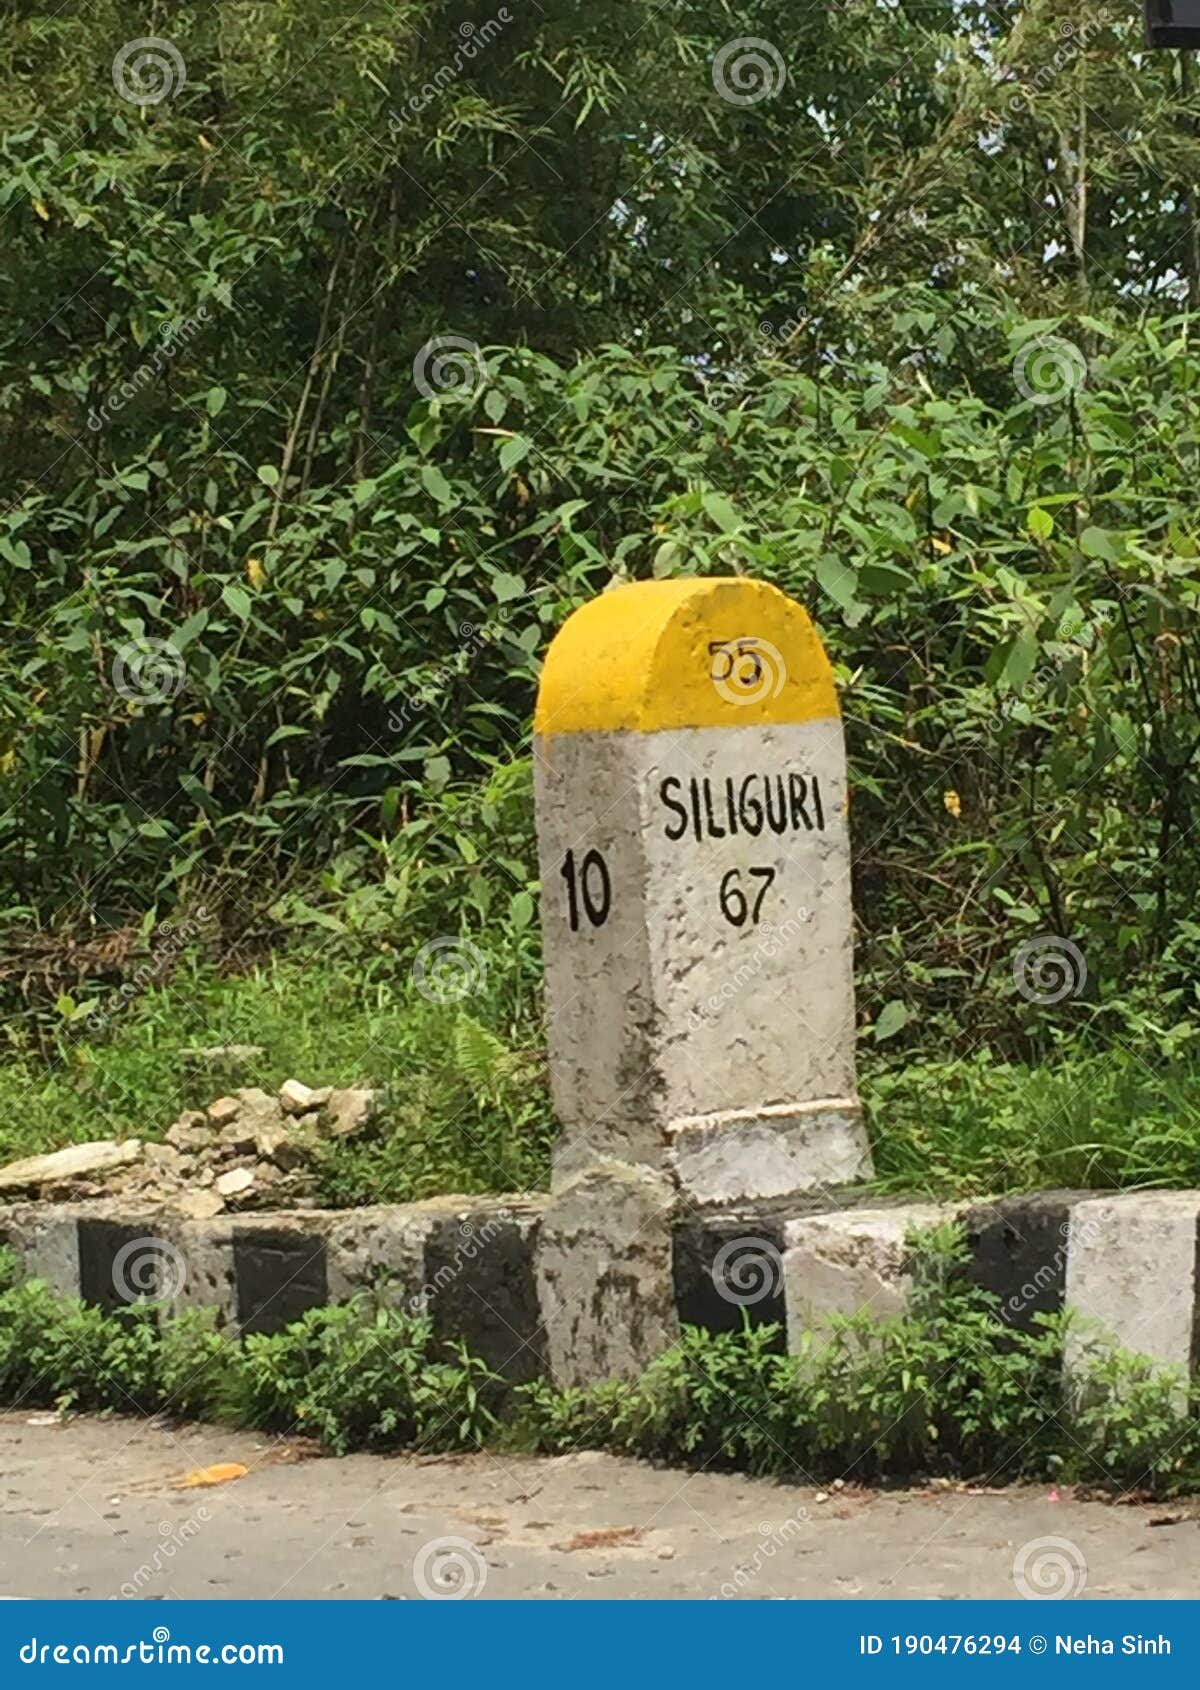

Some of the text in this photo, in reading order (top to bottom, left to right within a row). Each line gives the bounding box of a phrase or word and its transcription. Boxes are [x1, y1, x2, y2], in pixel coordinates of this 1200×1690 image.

[708, 640, 763, 686] 55
[659, 772, 825, 842] SILIGURI
[561, 848, 611, 932] 10
[719, 867, 776, 927] 67
